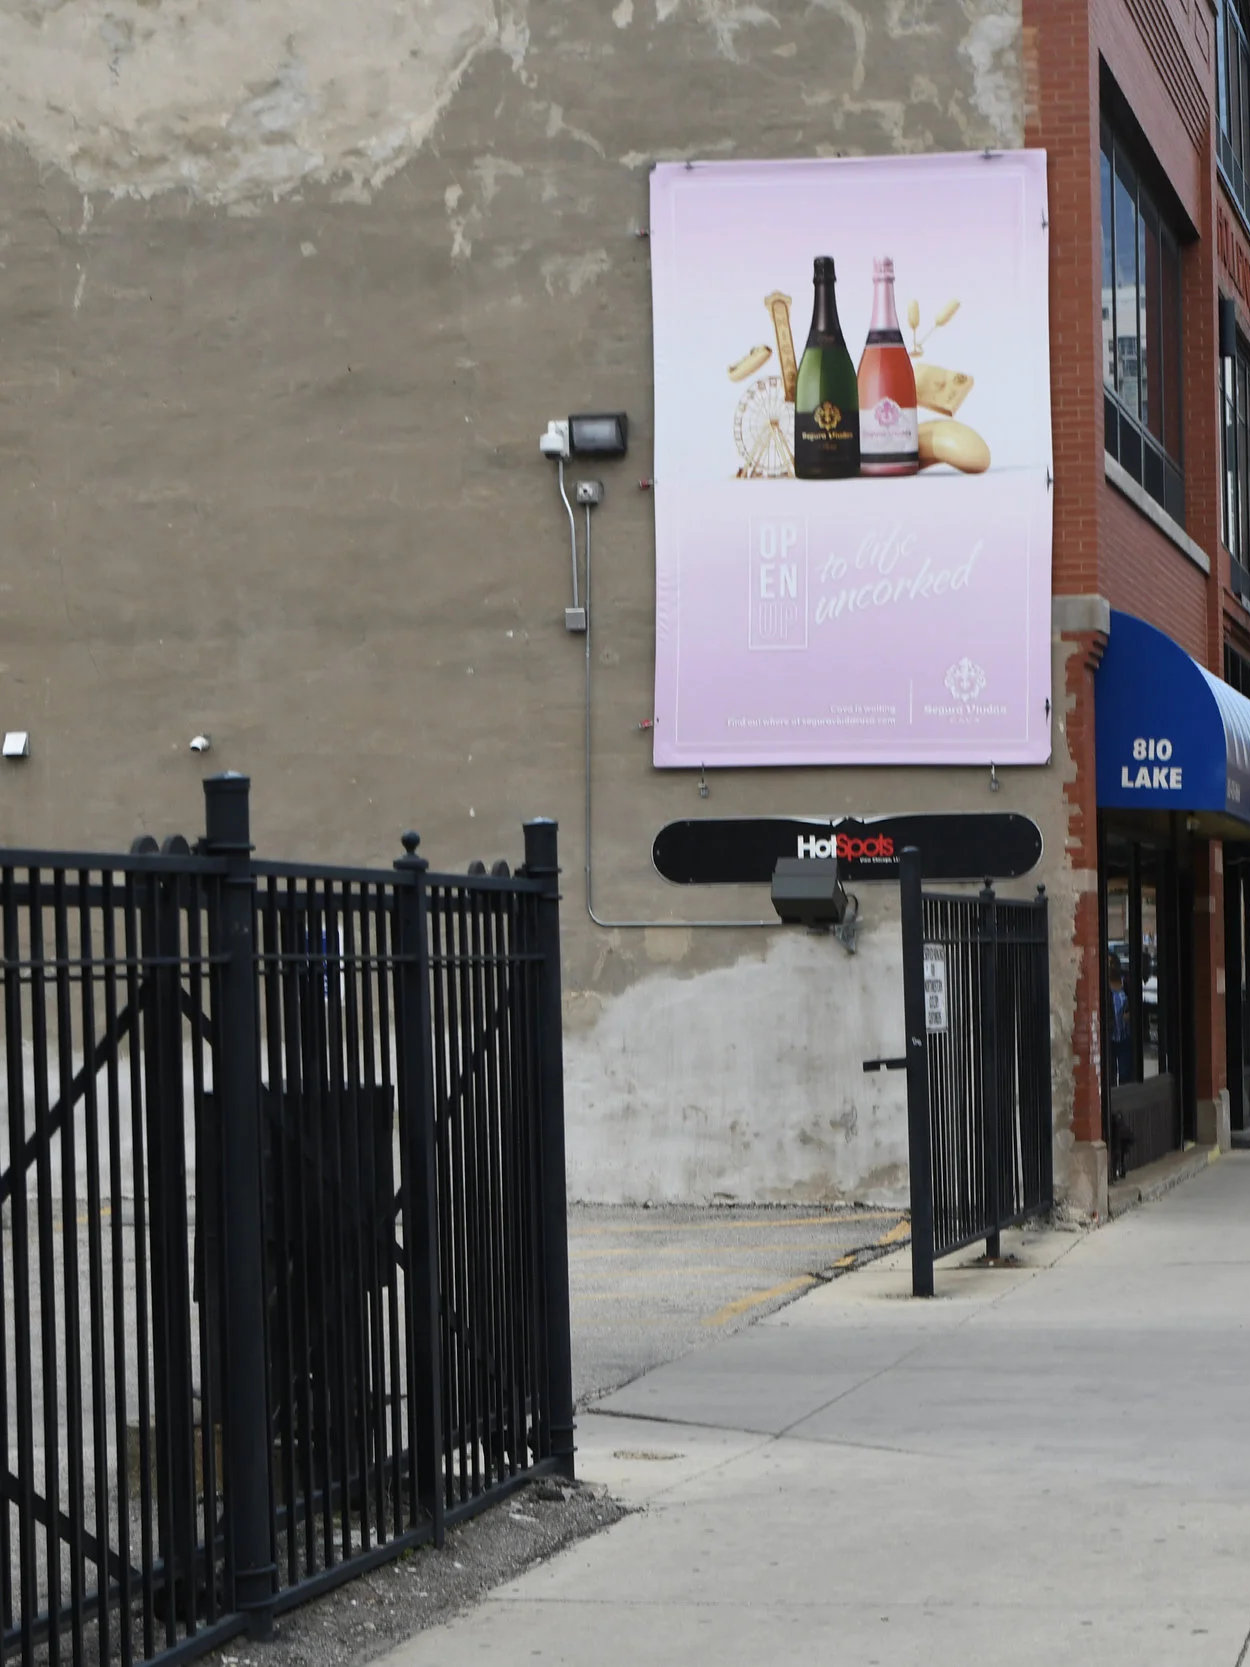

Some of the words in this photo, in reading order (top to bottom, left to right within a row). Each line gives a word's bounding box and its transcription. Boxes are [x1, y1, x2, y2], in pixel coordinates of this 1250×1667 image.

[818, 550, 847, 584] to
[854, 518, 918, 576] life
[814, 537, 985, 625] uncorked
[758, 601, 797, 639] UP
[1132, 738, 1173, 761] 810
[1121, 766, 1182, 789] LAKE
[797, 833, 894, 862] HotSpots
